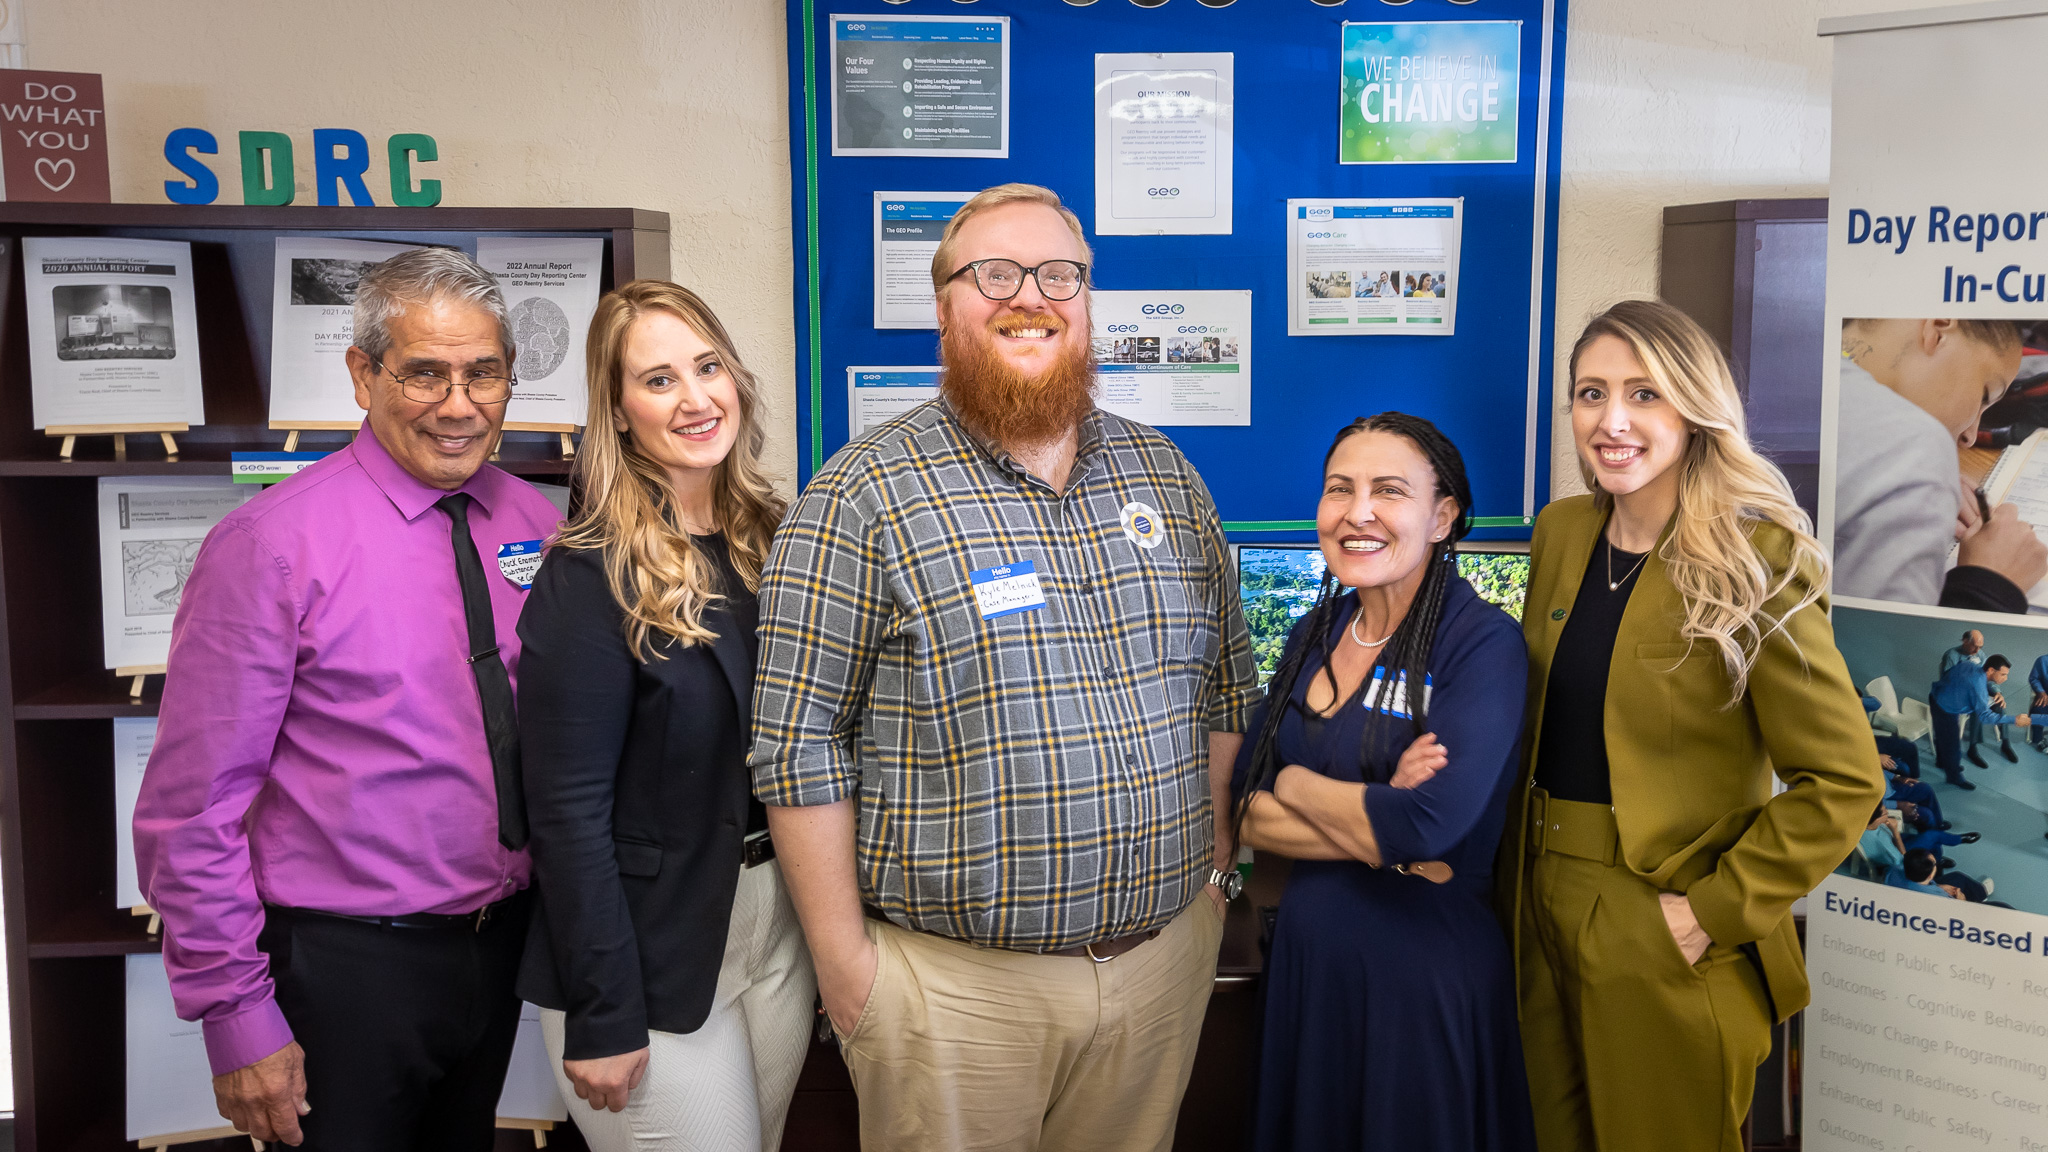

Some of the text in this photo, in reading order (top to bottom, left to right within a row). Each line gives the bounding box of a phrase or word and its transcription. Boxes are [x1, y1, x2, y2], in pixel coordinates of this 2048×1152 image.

[846, 66, 868, 74] Values
[1363, 54, 1497, 82] WE BELIEVE IN
[24, 82, 77, 103] DO
[1360, 81, 1499, 124] CHANGE
[0, 103, 103, 127] WHAT
[17, 129, 90, 151] YOU
[163, 127, 443, 208] SDRC
[1148, 188, 1180, 196] GEO
[1848, 205, 2048, 255] Day Repor
[45, 264, 146, 273] 2020 ANNUAL REPORT
[506, 262, 572, 270] 2022 Annual Report
[1943, 264, 2048, 303] In-Cu
[1142, 304, 1184, 314] GEO
[1108, 324, 1138, 332] GEO
[991, 566, 1012, 576] Hello
[978, 579, 1036, 599] Kyle Melnick
[1825, 890, 2033, 954] Evidence-Based
[1822, 934, 1886, 963] Enhanced
[1896, 952, 1940, 975] Public
[1948, 964, 1996, 990] Safety
[1822, 972, 1888, 1001] Outcomes
[1907, 994, 1977, 1022] Cognitive
[1822, 1008, 2048, 1080] Behavior Change Programming
[1820, 1044, 2043, 1114] Employment Readiness Career
[1820, 1081, 1884, 1113] Enhanced
[1894, 1103, 1937, 1128] Public
[1947, 1118, 1993, 1145] Safety
[1819, 1118, 1885, 1151] Outcomes
